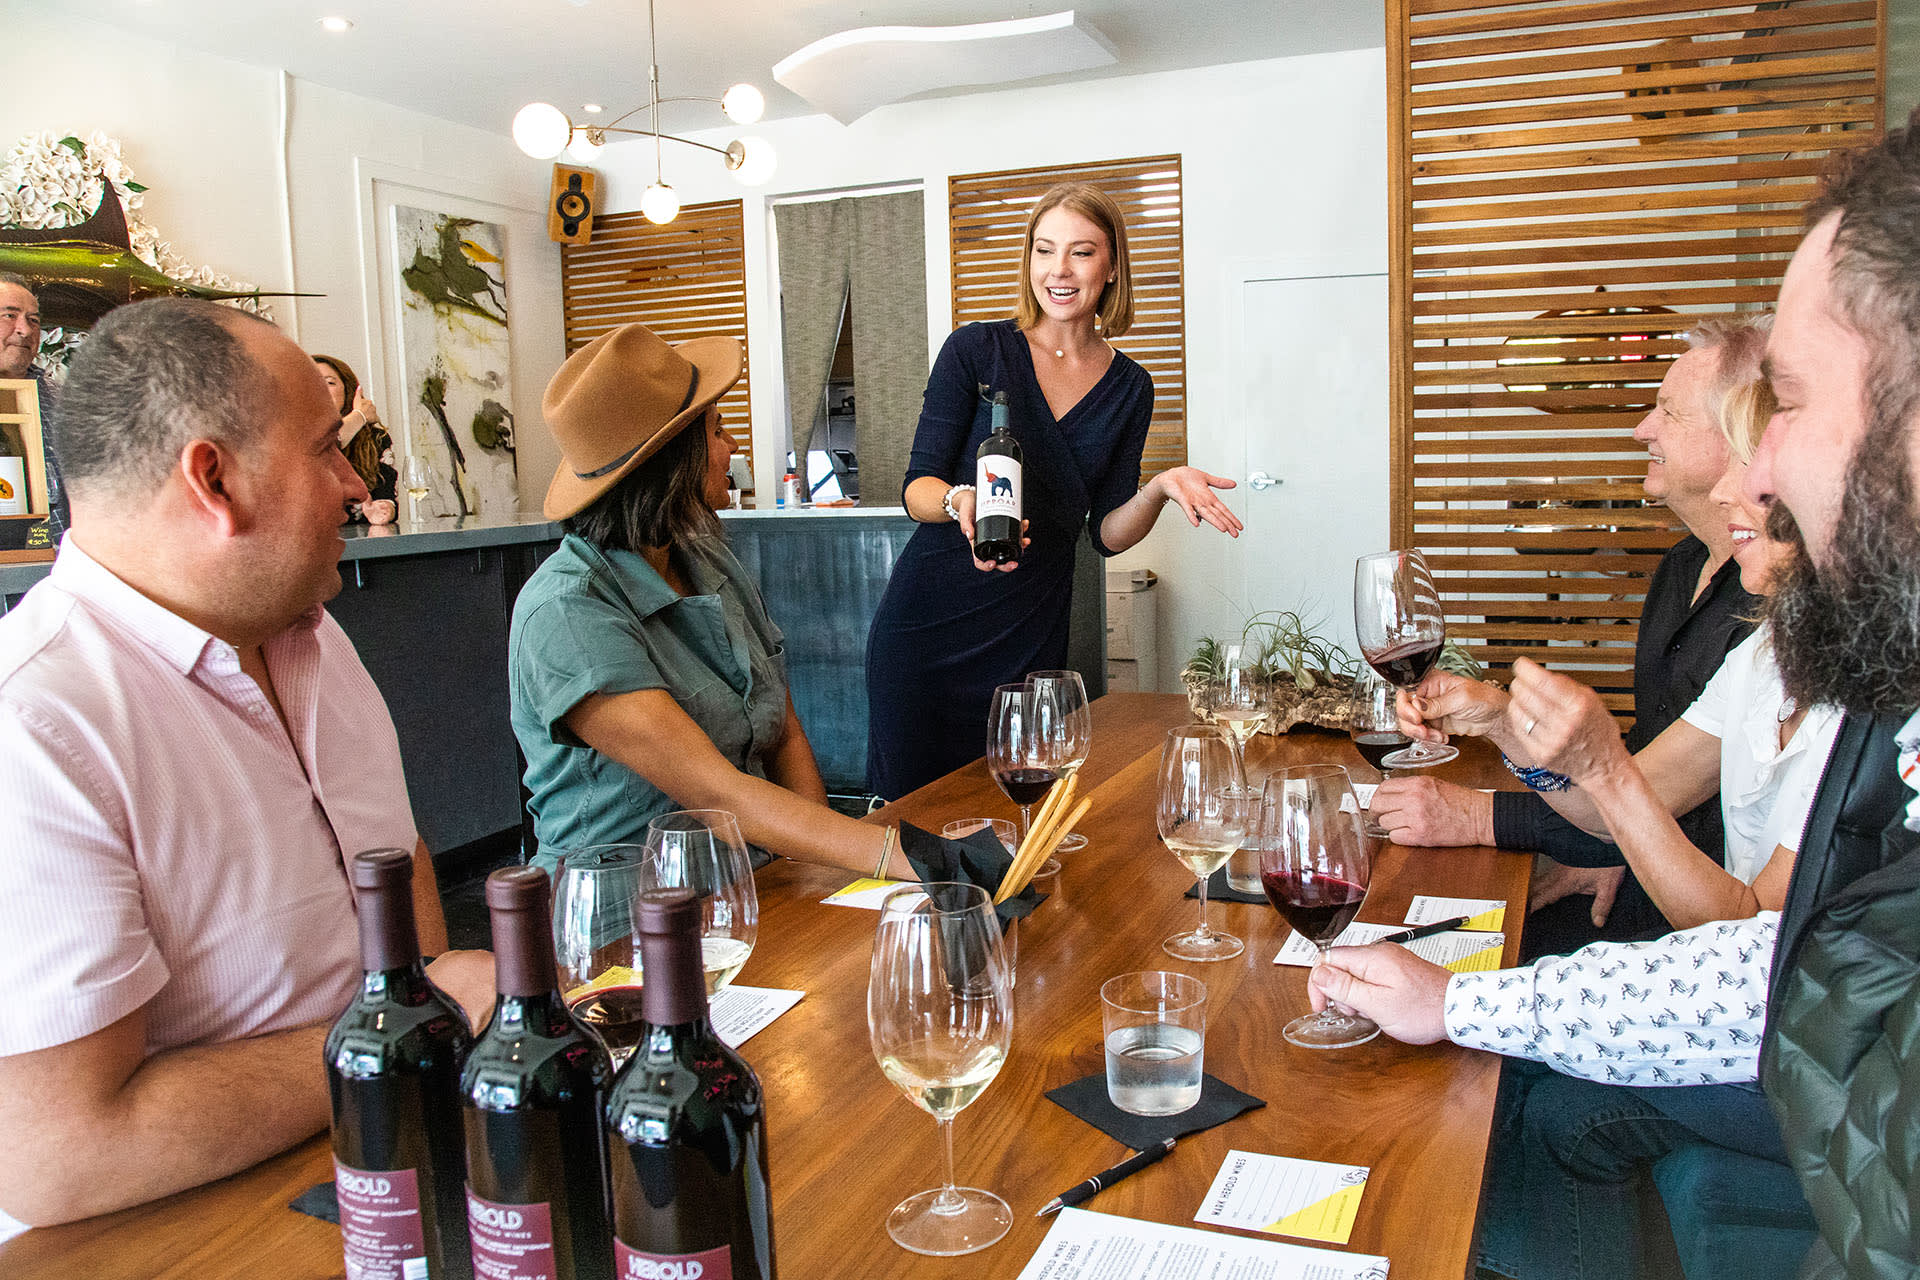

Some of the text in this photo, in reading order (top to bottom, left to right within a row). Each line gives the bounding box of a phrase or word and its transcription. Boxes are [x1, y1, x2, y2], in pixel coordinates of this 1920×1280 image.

[1211, 1200, 1226, 1216] MARK
[1220, 1176, 1238, 1199] HEROLD
[1232, 1158, 1247, 1175] WINES
[468, 1197, 523, 1231] OLD
[628, 1254, 704, 1280] HEROLD
